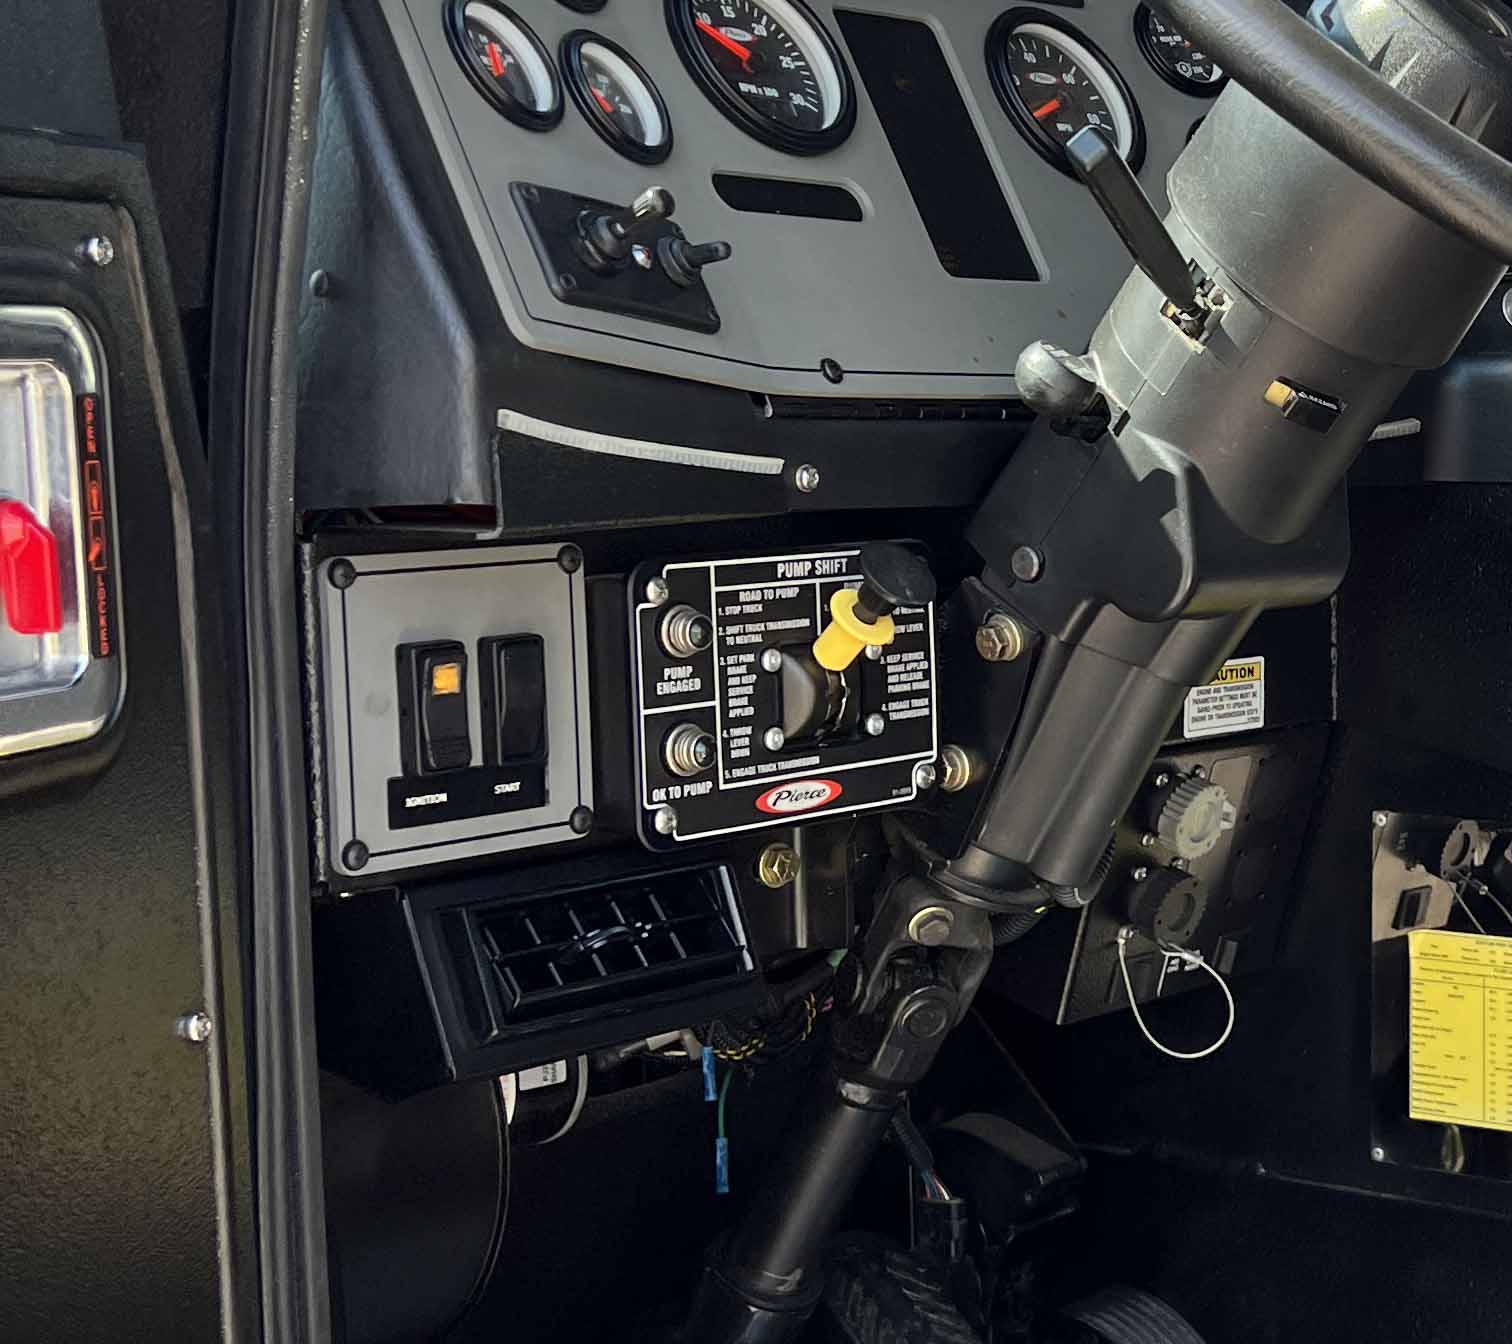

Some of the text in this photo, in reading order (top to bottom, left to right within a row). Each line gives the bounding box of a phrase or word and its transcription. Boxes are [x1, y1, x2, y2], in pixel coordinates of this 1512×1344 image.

[720, 4, 736, 18] 15
[751, 22, 768, 37] 20
[779, 56, 795, 69] 25
[789, 92, 805, 106] 30
[777, 558, 848, 578] PUMP SHIFT
[739, 587, 800, 602] ROAD TO PUMP
[724, 606, 741, 616] STOP
[742, 603, 763, 614] TRUCK
[726, 636, 735, 645] TO
[663, 666, 693, 680] PUMP
[1216, 666, 1254, 681] AUTION
[656, 678, 701, 695] ENGAGED
[493, 782, 521, 795] START
[652, 781, 713, 802] OK TO PUMP
[772, 788, 827, 807] Pierce
